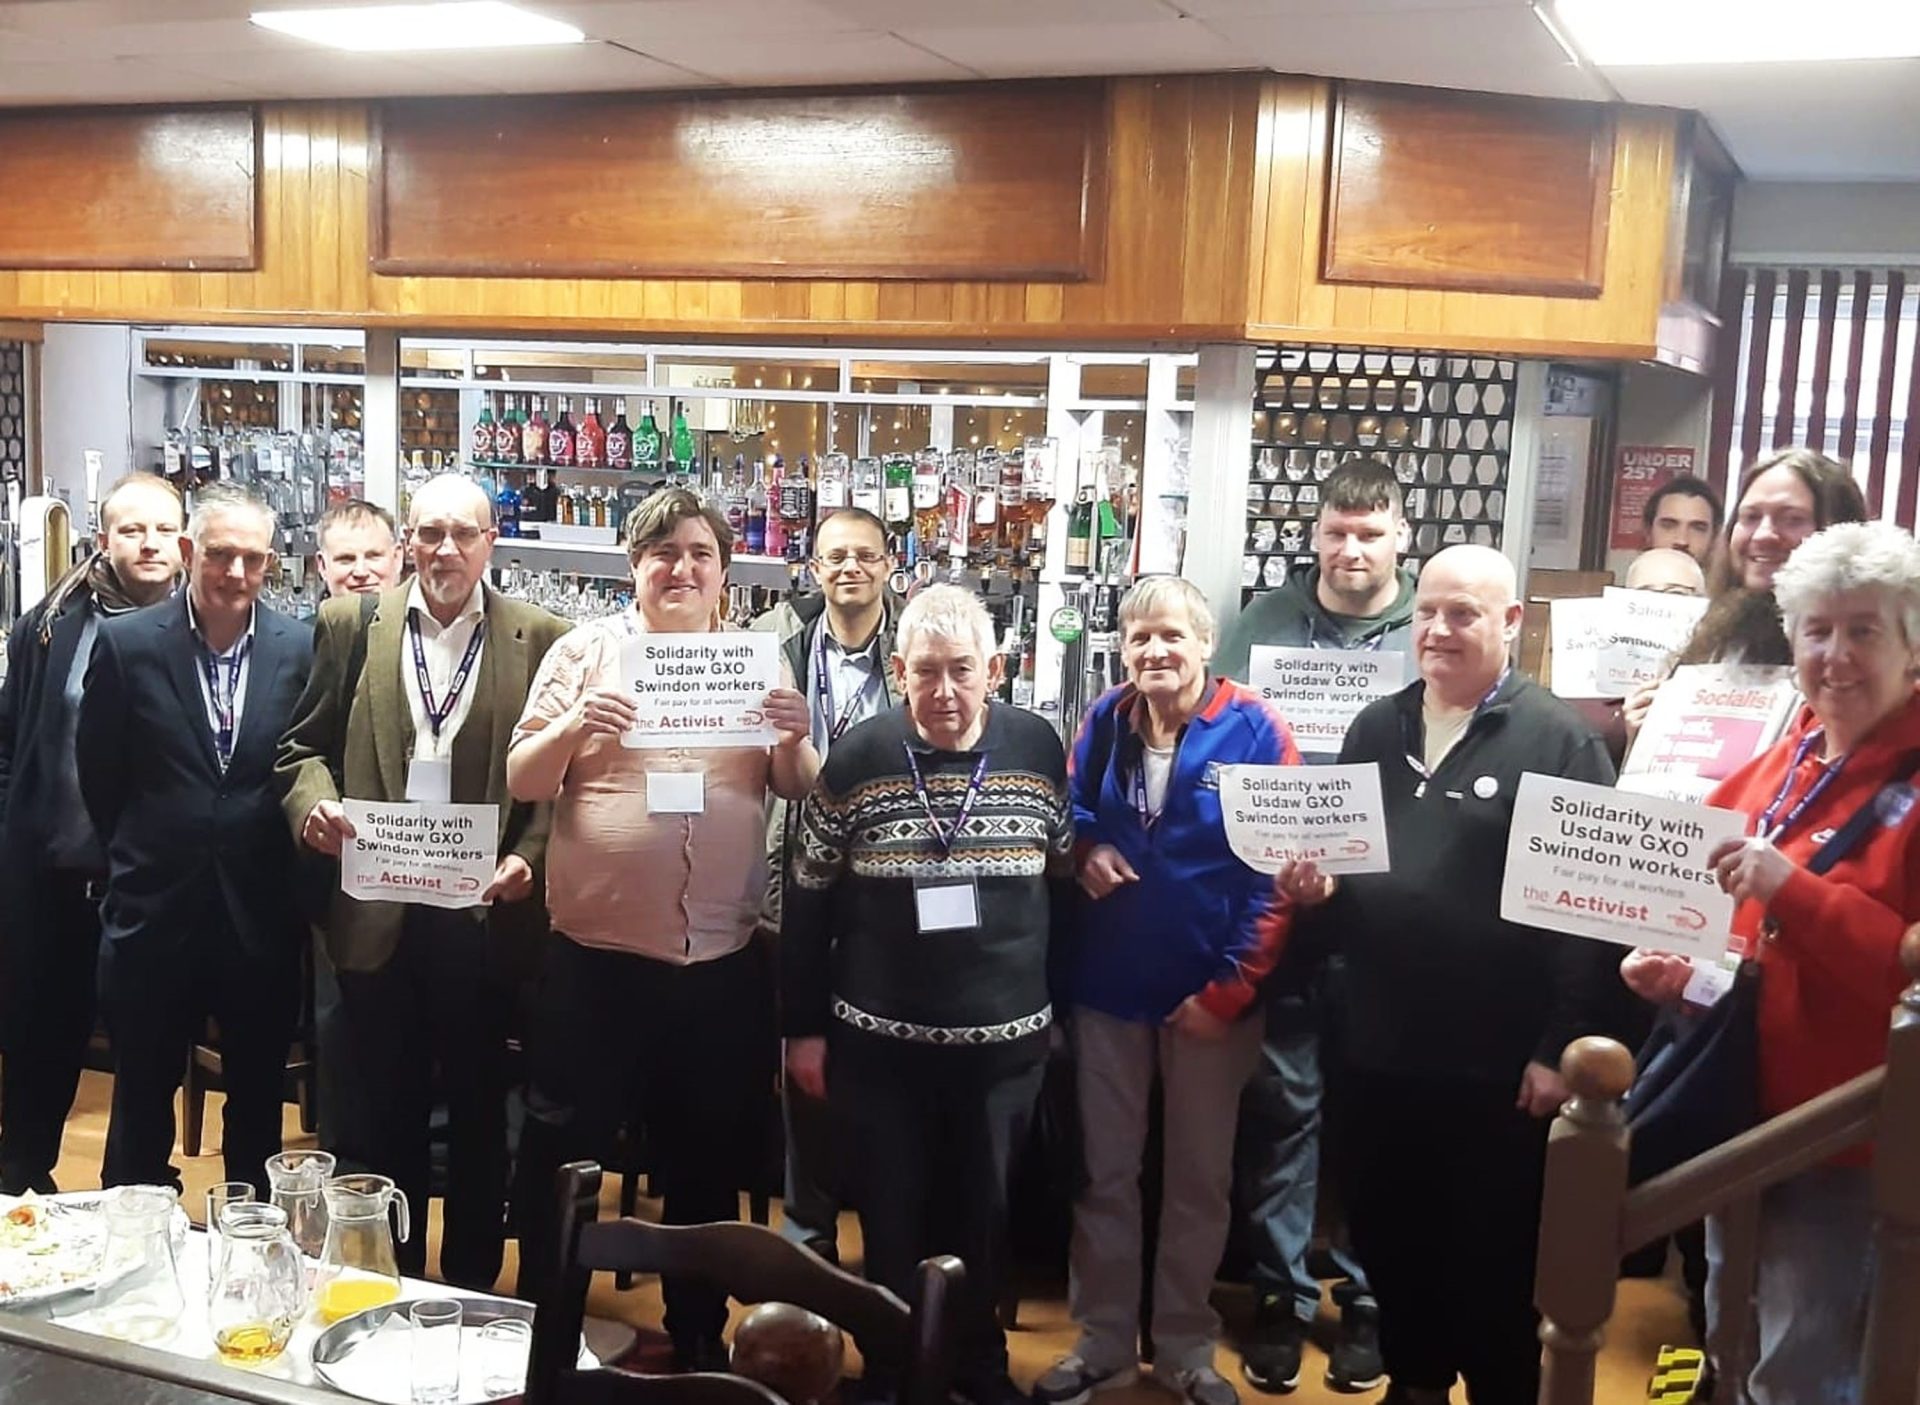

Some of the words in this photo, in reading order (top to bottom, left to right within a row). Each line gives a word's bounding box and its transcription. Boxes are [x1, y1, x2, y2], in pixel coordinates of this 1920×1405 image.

[1624, 452, 1691, 468] UNDER
[1622, 466, 1657, 480] 25?
[646, 646, 717, 661] Solidarity
[723, 645, 754, 658] with
[655, 663, 706, 676] Usdaw
[711, 662, 745, 674] GXO
[1274, 658, 1343, 674] Solidarity
[1347, 660, 1378, 673] with
[635, 680, 700, 693] Swindon
[705, 679, 766, 691] workers
[1281, 674, 1330, 686] Usdaw
[1335, 676, 1368, 688] GXO
[654, 698, 670, 707] Fair
[672, 698, 688, 707] pay
[690, 697, 701, 706] for
[703, 697, 712, 706] all
[714, 697, 746, 706] workers
[1263, 688, 1324, 701] Swindon
[1329, 691, 1384, 703] worker
[1692, 689, 1777, 710] Socialist
[659, 715, 724, 729] Activist
[1287, 722, 1346, 735] Activist
[1242, 777, 1312, 794] Solidarity
[1317, 778, 1351, 791] with
[1252, 795, 1301, 808] Usdaw
[1306, 795, 1344, 808] GXO
[367, 812, 437, 831] Solidarity
[442, 815, 473, 829] with
[1235, 810, 1297, 825] Swindon
[1301, 811, 1367, 825] workers
[1551, 796, 1653, 830] Solidarity
[1659, 816, 1704, 840] with
[376, 828, 424, 843] Usdaw
[430, 832, 464, 845] GXO
[1560, 820, 1632, 846] Usdaw
[1640, 834, 1688, 857] GXO
[356, 838, 419, 857] Swindon
[423, 848, 483, 861] workers
[1264, 846, 1326, 860] Activist
[393, 858, 407, 868] pay
[1529, 836, 1621, 867] Swindon
[1629, 856, 1715, 886] workers
[380, 871, 442, 889] Activist
[1553, 866, 1574, 879] Fair
[1577, 871, 1598, 885] pay
[1603, 874, 1620, 887] for
[1622, 879, 1635, 890] all
[1638, 881, 1685, 899] workers
[1523, 885, 1549, 902] the
[1556, 889, 1648, 921] Activist
